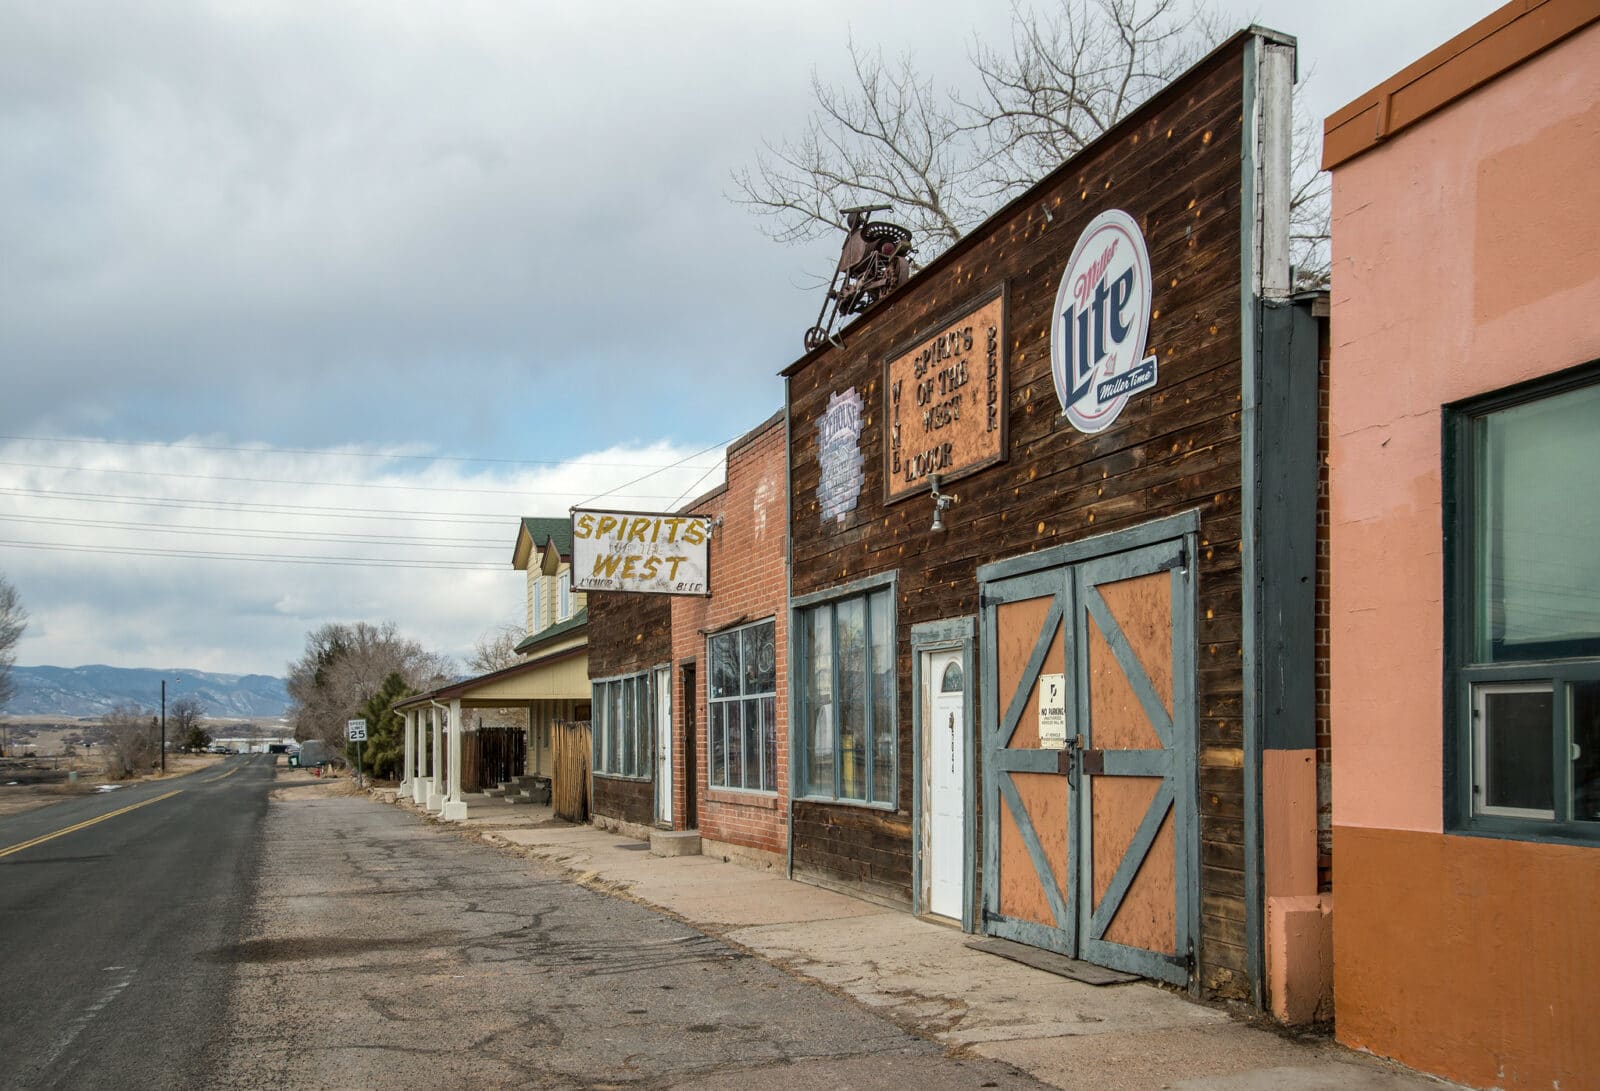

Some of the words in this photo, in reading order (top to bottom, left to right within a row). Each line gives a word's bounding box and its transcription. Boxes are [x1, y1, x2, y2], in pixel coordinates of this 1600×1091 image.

[1073, 237, 1120, 308] Miller
[914, 326, 974, 380] SPIRITS
[1062, 265, 1136, 410] Lite
[916, 377, 935, 406] OF
[938, 359, 970, 396] THE
[1099, 378, 1130, 401] Miller
[1128, 367, 1152, 387] Time
[923, 395, 962, 433] WEST
[904, 442, 953, 483] LIQUOR
[574, 514, 706, 546] SPIRITS
[592, 552, 689, 582] WEST
[1041, 708, 1047, 716] NO
[1049, 707, 1064, 716] PARKING
[350, 730, 365, 739] 25
